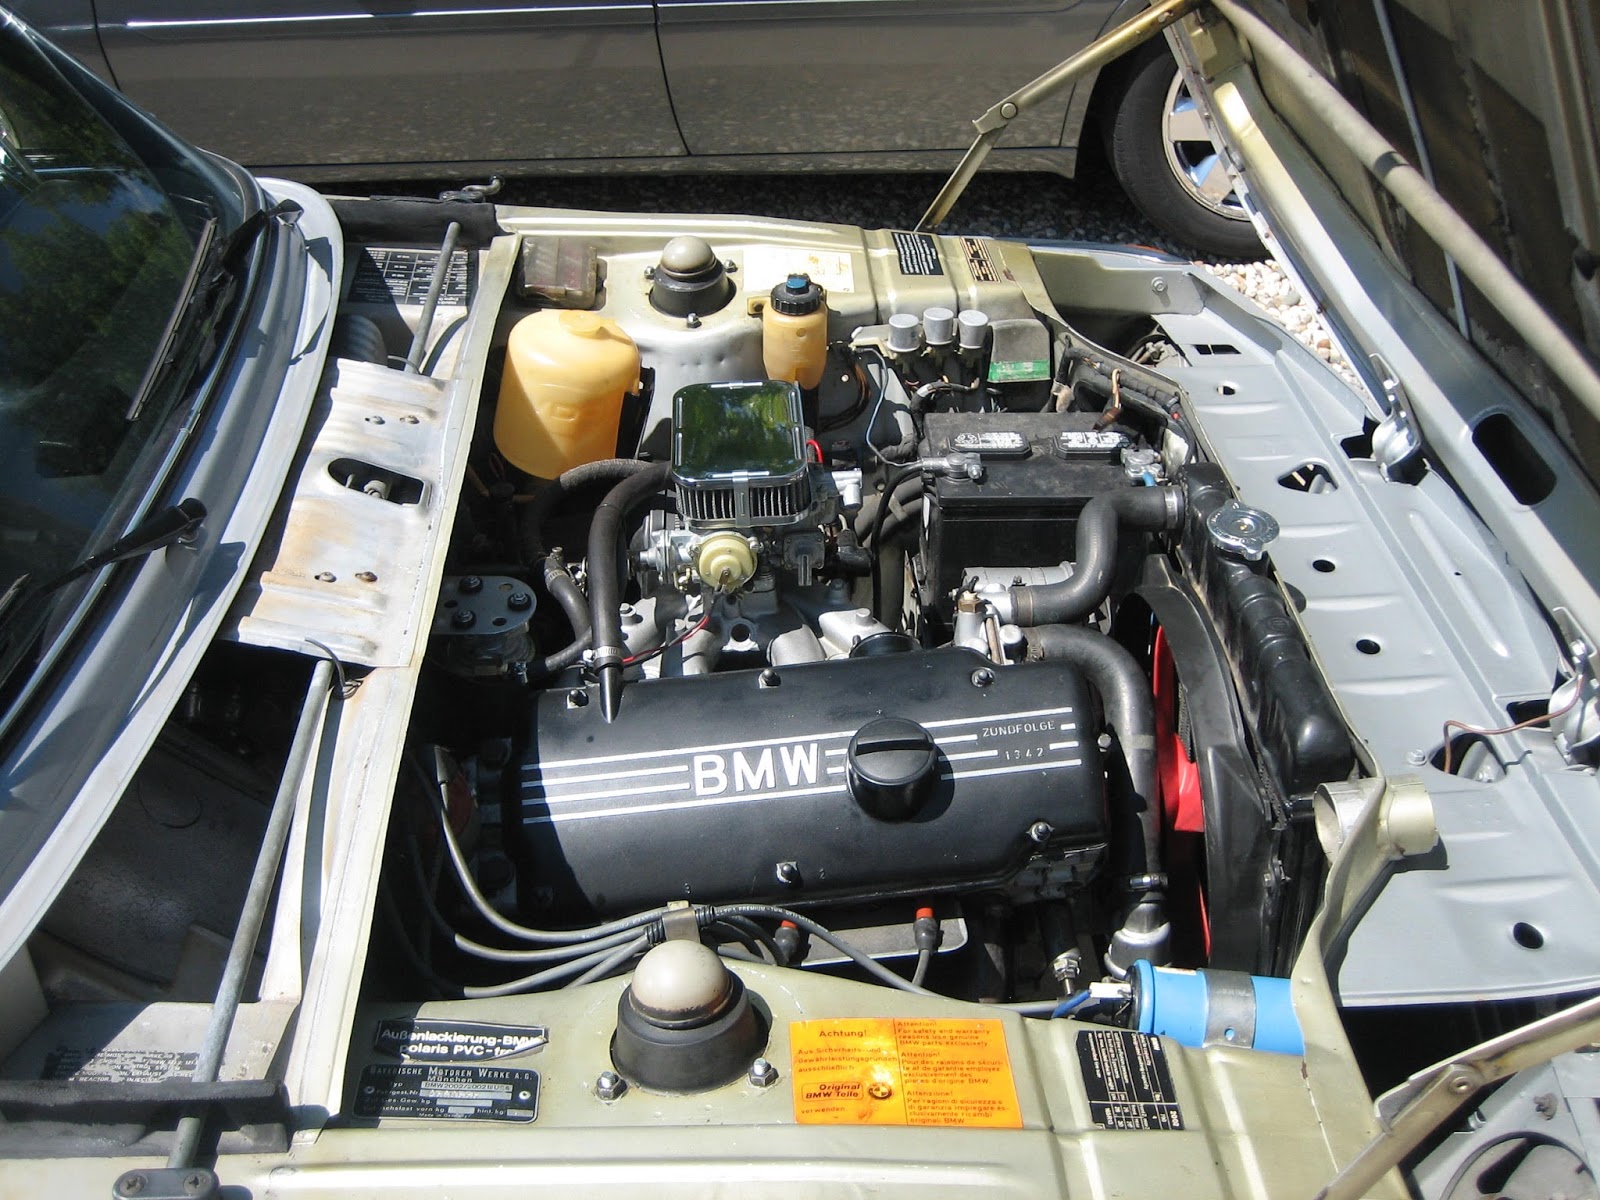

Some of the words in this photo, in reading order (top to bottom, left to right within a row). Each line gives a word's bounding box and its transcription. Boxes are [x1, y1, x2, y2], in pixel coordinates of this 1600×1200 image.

[693, 743, 819, 797] BMW
[429, 1066, 472, 1077] MOTOREN
[478, 1068, 510, 1079] WERKE
[1170, 1111, 1179, 1127] 2002
